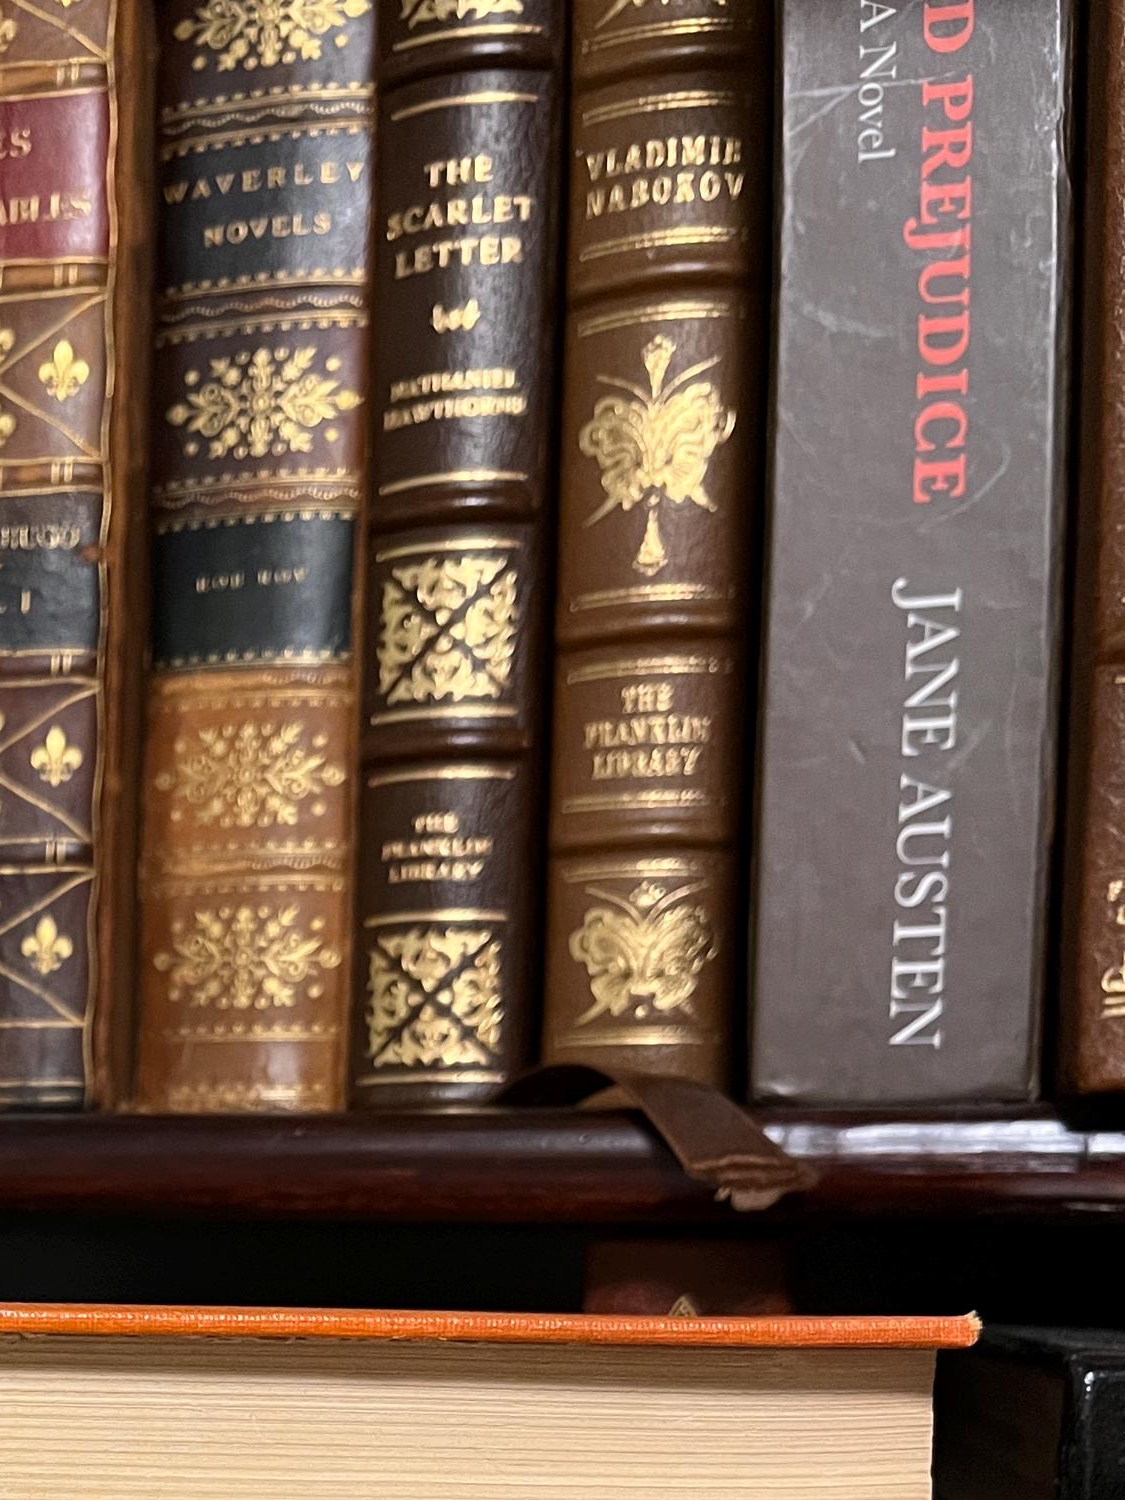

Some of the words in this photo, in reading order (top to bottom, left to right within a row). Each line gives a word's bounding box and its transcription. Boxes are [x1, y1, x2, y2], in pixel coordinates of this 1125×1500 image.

[859, 0, 897, 33] A
[857, 41, 898, 164] Novel
[424, 153, 494, 188] THE
[586, 135, 742, 181] VLADIMIR
[163, 161, 365, 205] WAVERLEY
[586, 170, 745, 220] NABOKOV
[203, 211, 332, 249] NOVELS
[386, 195, 533, 241] SCARLET
[394, 235, 524, 279] LETTER
[903, 73, 974, 505] PREJUDICE
[890, 577, 963, 757] JANE
[622, 682, 675, 714] THE
[592, 746, 703, 780] LIBRARY
[888, 774, 953, 1049] AUSTEN
